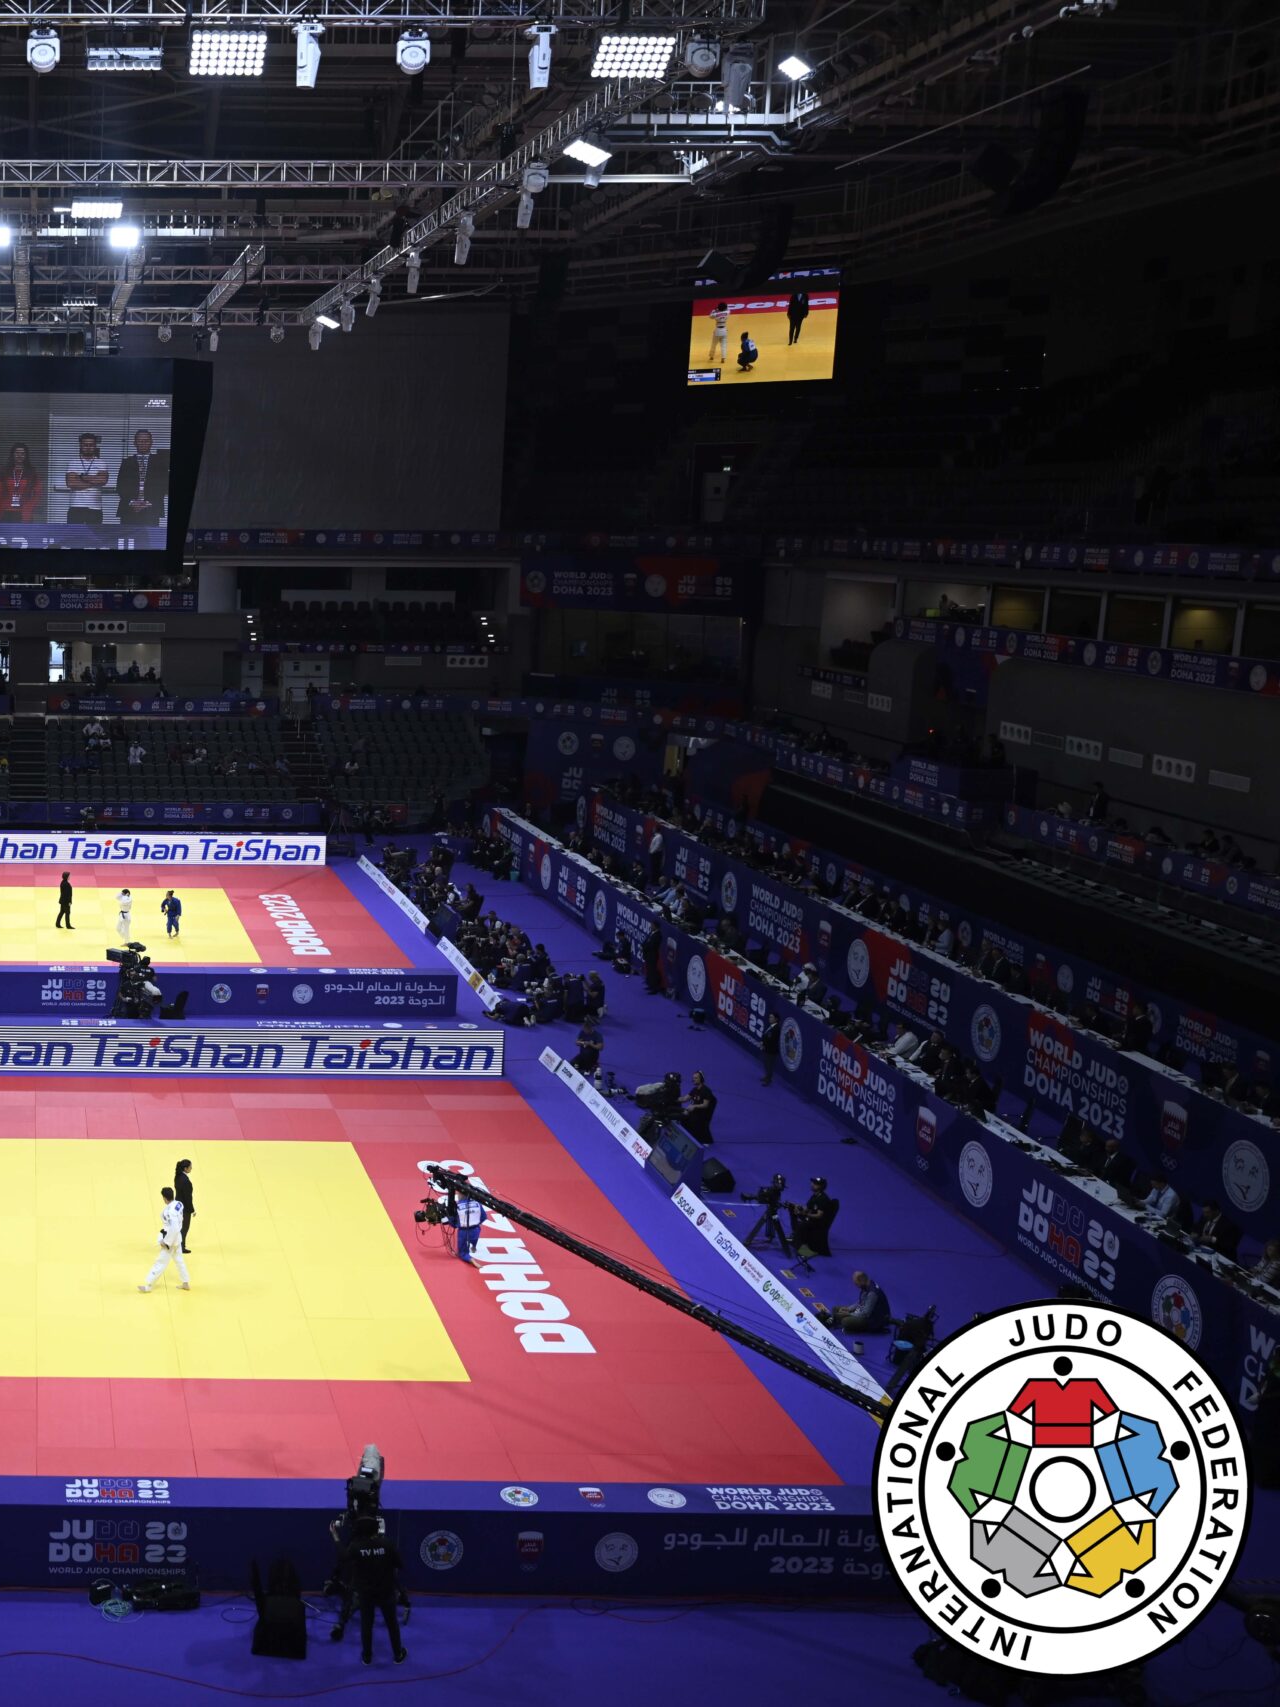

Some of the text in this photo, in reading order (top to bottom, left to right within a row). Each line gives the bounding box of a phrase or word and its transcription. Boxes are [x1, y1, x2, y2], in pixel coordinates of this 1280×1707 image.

[552, 586, 613, 596] DOHA 2023
[67, 837, 190, 861] TaiShan
[199, 838, 321, 862] TaiShan
[751, 883, 804, 922] WORLD JUDO
[257, 893, 332, 956] 2023 DOHA
[748, 910, 801, 954] DOHA 2023
[86, 979, 107, 990] 20
[86, 990, 107, 1001] 23
[374, 995, 405, 1006] 2023
[90, 1033, 284, 1069] TaiShan
[300, 1035, 496, 1071] TaiShan
[1175, 1034, 1207, 1060] DOHA
[822, 1038, 896, 1102] WORLD JUDO
[1029, 1027, 1129, 1096] WORLD JUDO
[819, 1058, 895, 1121] CHAMPIONSHIPS
[1026, 1048, 1127, 1115] CHAMPIONSHIPS
[817, 1073, 893, 1144] DOHA 2023
[1023, 1064, 1126, 1140] DOHA 2023
[677, 1196, 695, 1217] SOCAR
[713, 1230, 740, 1262] TaiShan
[1016, 1231, 1040, 1255] WORLD
[1017, 1200, 1117, 1292] DOHA 23
[1086, 1218, 1120, 1261] 20
[468, 1237, 598, 1354] DOHA
[65, 1488, 170, 1499] DOHA 23
[136, 1479, 169, 1489] 20
[706, 1487, 824, 1496] WORLD JUDO
[711, 1494, 830, 1503] CHAMPIONSHIPS
[714, 1501, 836, 1511] DOHA 2023
[145, 1520, 188, 1541] 20
[48, 1542, 187, 1564] DOHA 23
[360, 1548, 371, 1557] TV
[48, 1566, 187, 1576] WORLD JUDO CHAMPIONSHIPS
[770, 1556, 834, 1574] 2023
